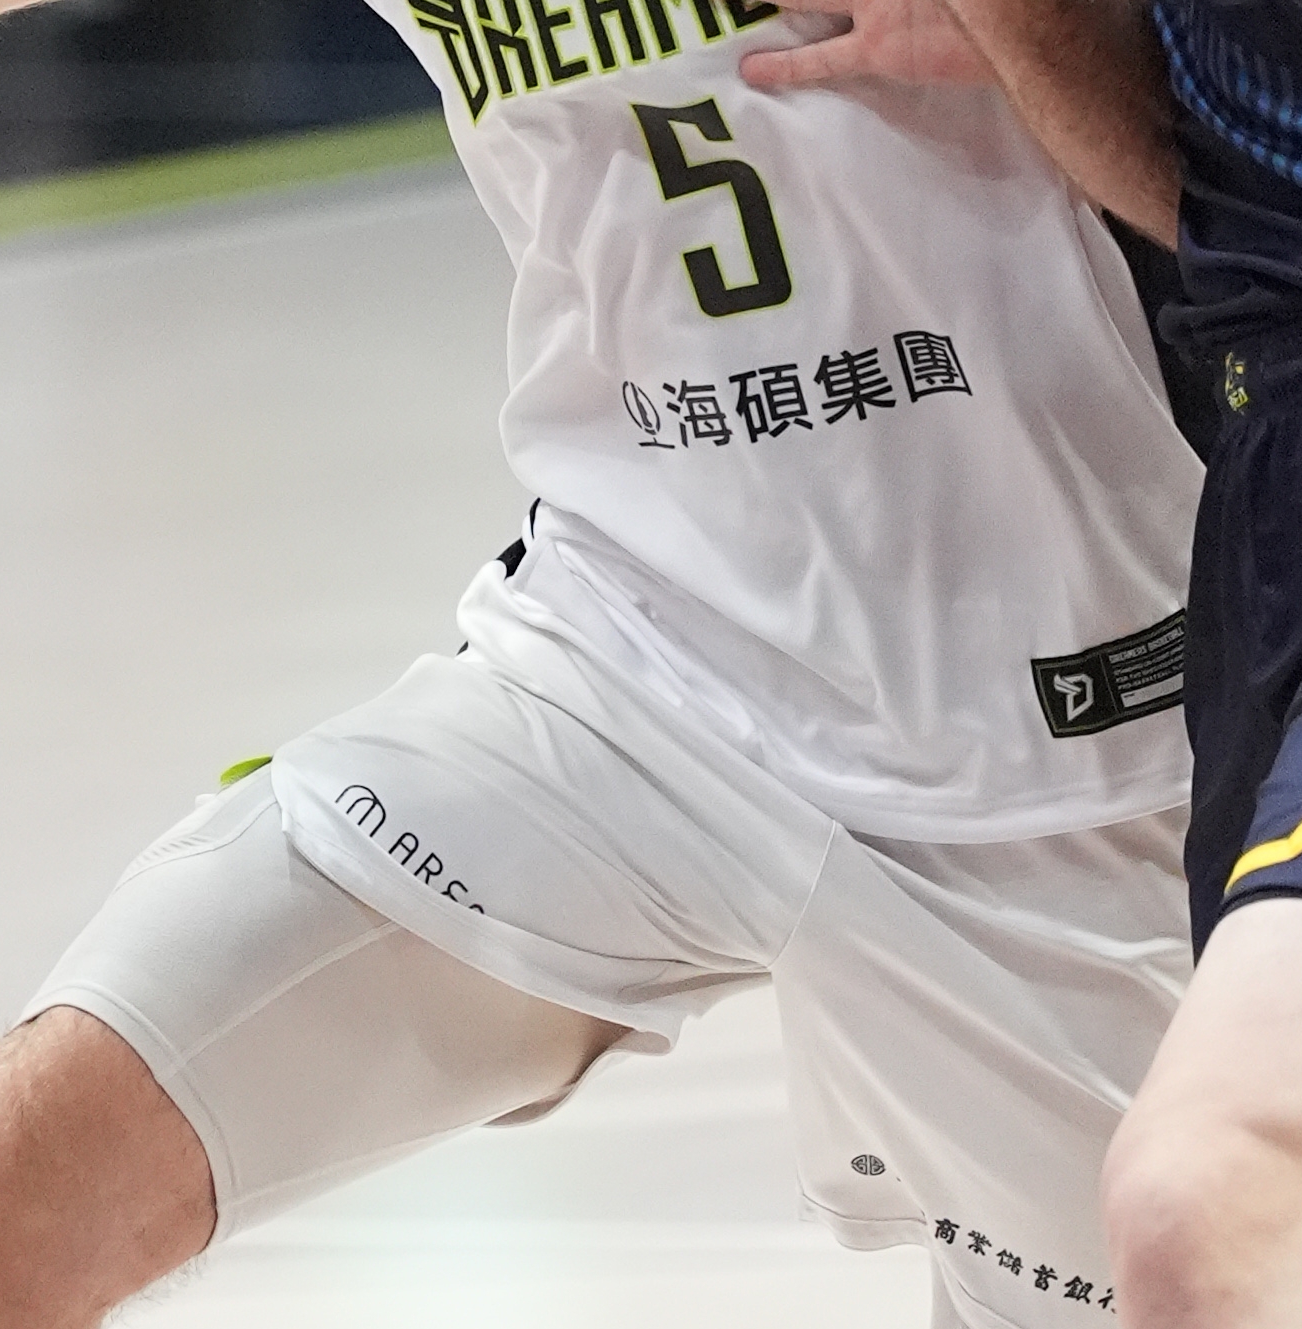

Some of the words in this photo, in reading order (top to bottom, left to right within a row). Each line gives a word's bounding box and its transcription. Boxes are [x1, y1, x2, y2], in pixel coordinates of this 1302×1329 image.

[629, 97, 793, 319] 5
[662, 330, 973, 449] 海碩集團
[334, 784, 486, 916] MARE
